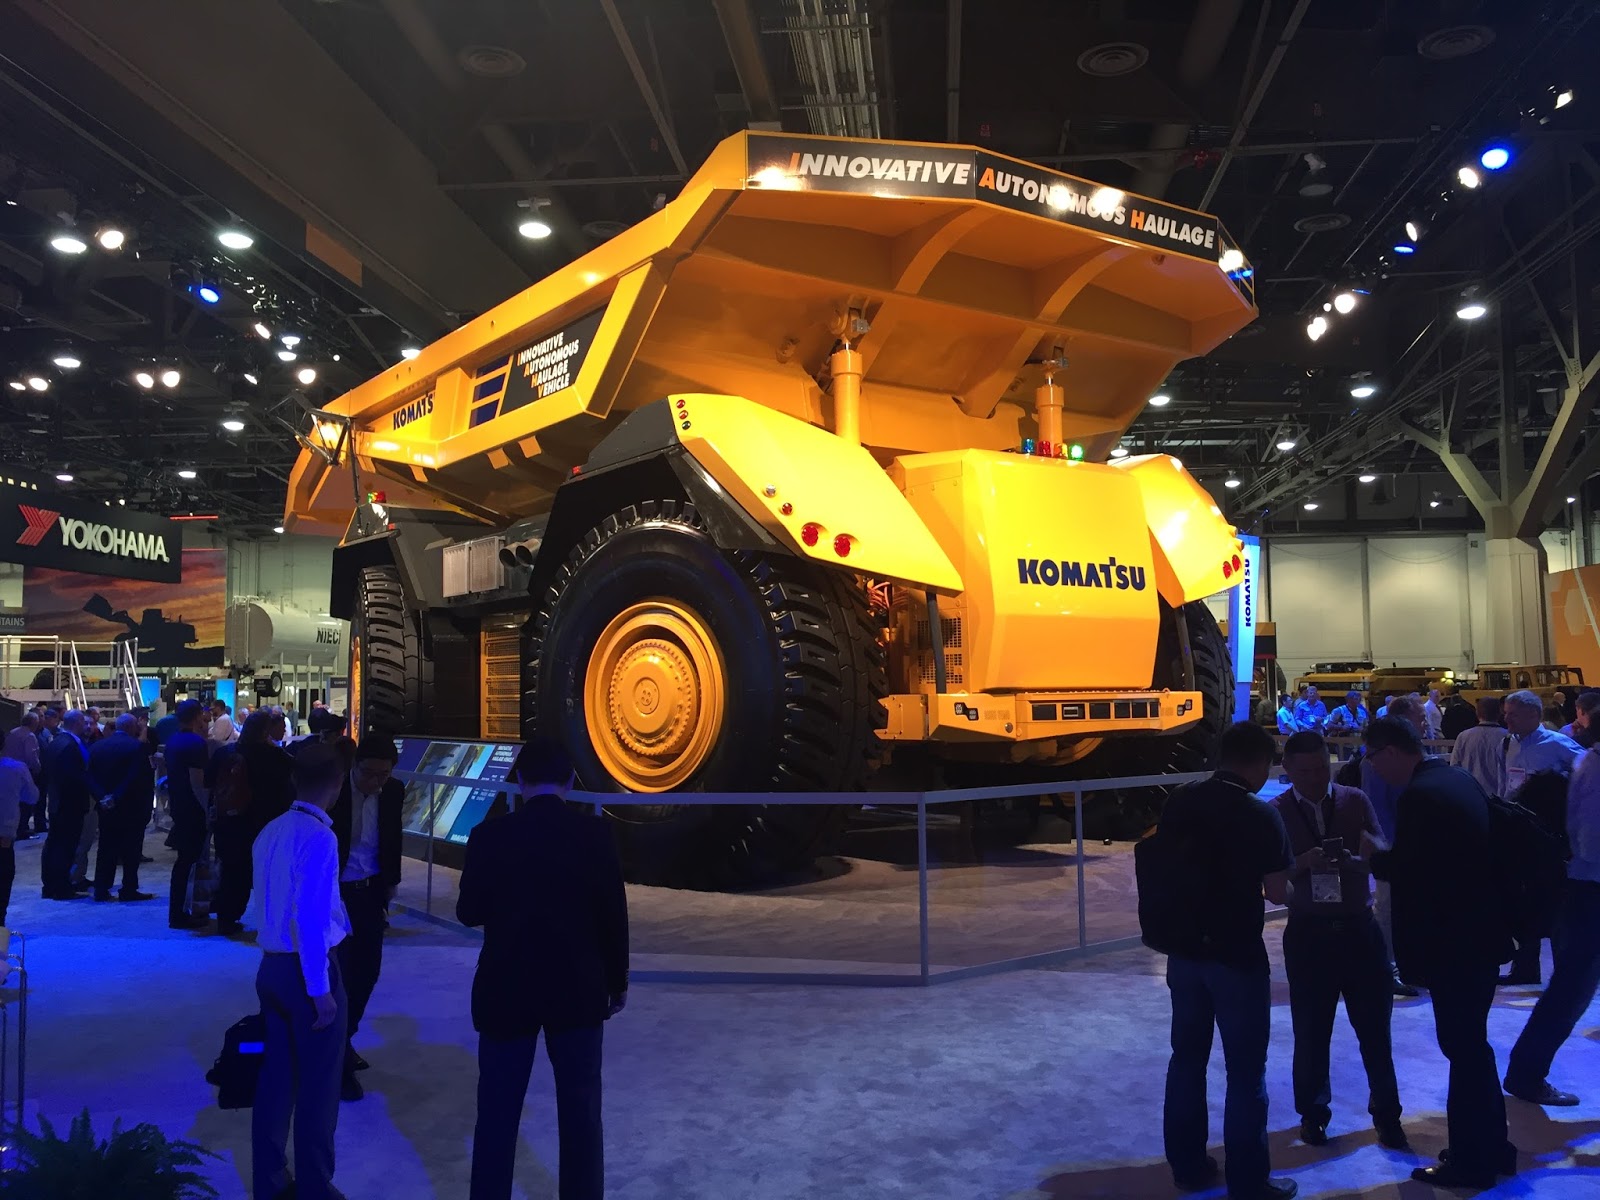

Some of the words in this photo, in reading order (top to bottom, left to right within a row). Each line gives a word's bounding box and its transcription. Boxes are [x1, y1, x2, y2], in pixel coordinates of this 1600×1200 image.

[788, 152, 971, 185] INNOVATIVE
[1130, 209, 1215, 249] HAULAGE
[516, 332, 564, 367] INNOVATIVE
[523, 339, 580, 378] AUTONOMOUS
[531, 359, 569, 388] HAULAGE
[537, 373, 571, 399] VEHICLE
[393, 391, 436, 431] KOMATS
[59, 516, 167, 562] YOKOHAMA
[1017, 556, 1146, 591] KOMATSU
[1244, 558, 1252, 628] KOMATSU
